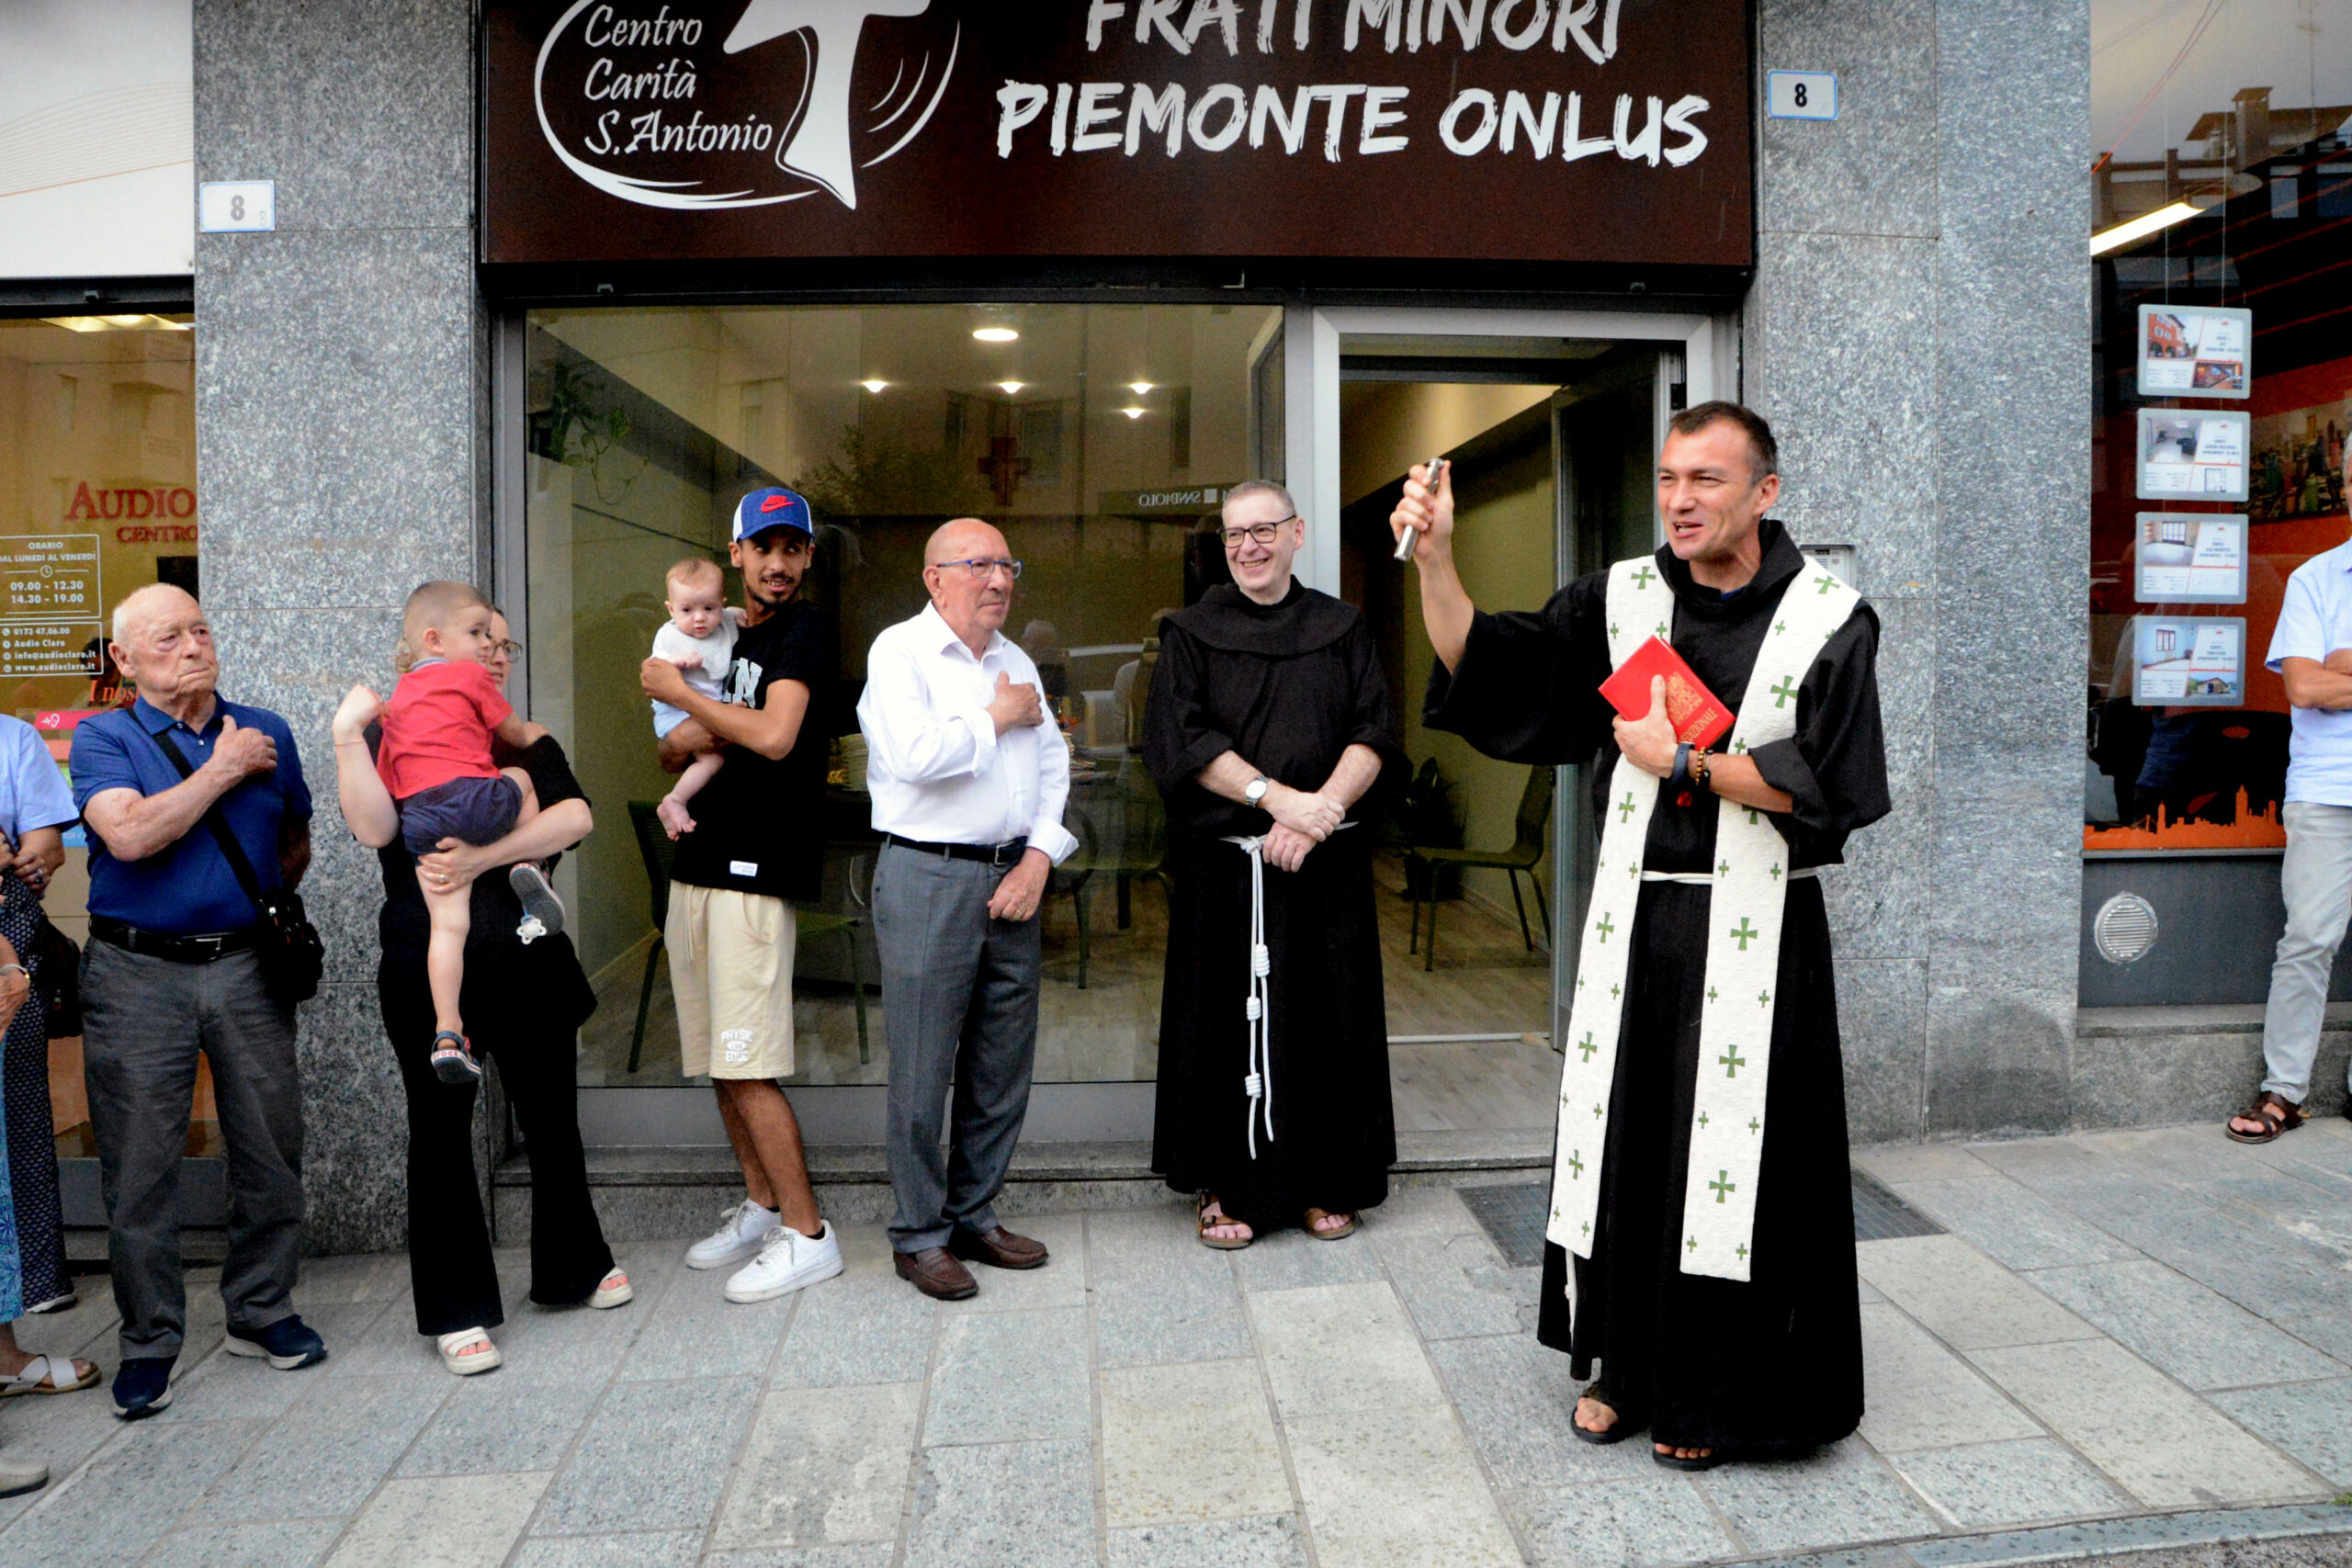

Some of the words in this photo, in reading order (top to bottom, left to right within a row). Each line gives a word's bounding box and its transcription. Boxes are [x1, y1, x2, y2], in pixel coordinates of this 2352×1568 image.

[584, 5, 702, 47] Centro
[1344, 0, 1621, 65] MINORI
[585, 59, 695, 100] Carità
[1795, 83, 1807, 107] 8
[584, 110, 772, 154] S.Antonio
[997, 80, 1409, 163] PIEMONTE
[1439, 88, 1710, 167] ONLUS
[231, 195, 244, 220] 8
[64, 480, 197, 520] AUDIO
[28, 541, 63, 549] ORARIO
[116, 525, 198, 543] CENTRO
[15, 552, 45, 562] LUNEDÌ
[60, 550, 96, 561] VENERDÌ
[10, 581, 41, 591] 09.00
[53, 581, 84, 590] 12.30
[11, 594, 41, 604] 14.30
[53, 593, 84, 603] 19.00
[14, 639, 40, 648] Audio
[42, 638, 66, 647] Claro
[14, 649, 96, 660] info@audioclaro.it
[15, 662, 96, 671] www.audioclaro.it
[90, 680, 97, 702] I
